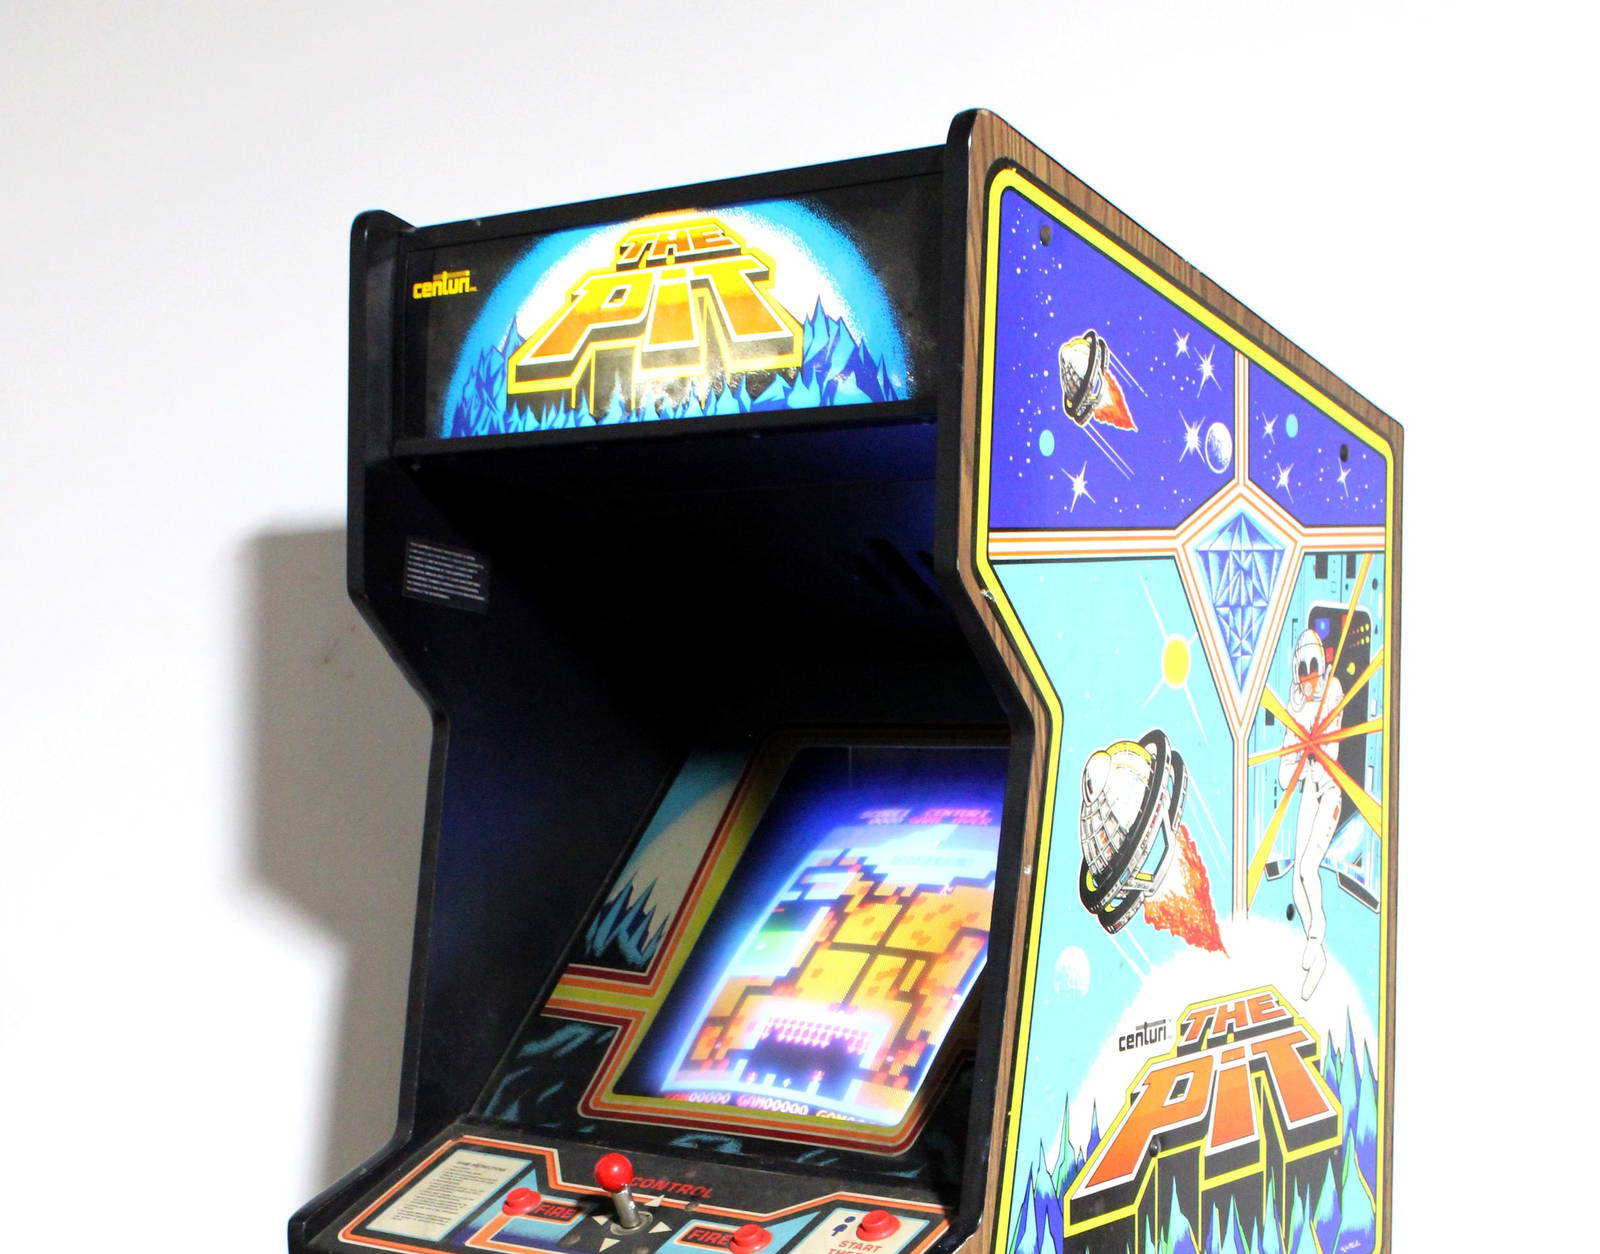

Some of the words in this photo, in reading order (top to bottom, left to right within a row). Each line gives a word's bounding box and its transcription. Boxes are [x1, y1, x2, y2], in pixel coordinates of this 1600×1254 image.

[616, 221, 744, 271] THE
[413, 270, 470, 299] centuri
[1118, 1019, 1167, 1052] centuri
[1178, 990, 1294, 1057] THE
[630, 1176, 713, 1198] CONTROL
[534, 1203, 577, 1219] FIRE
[687, 1229, 732, 1245] FIRE
[838, 1240, 883, 1253] START
